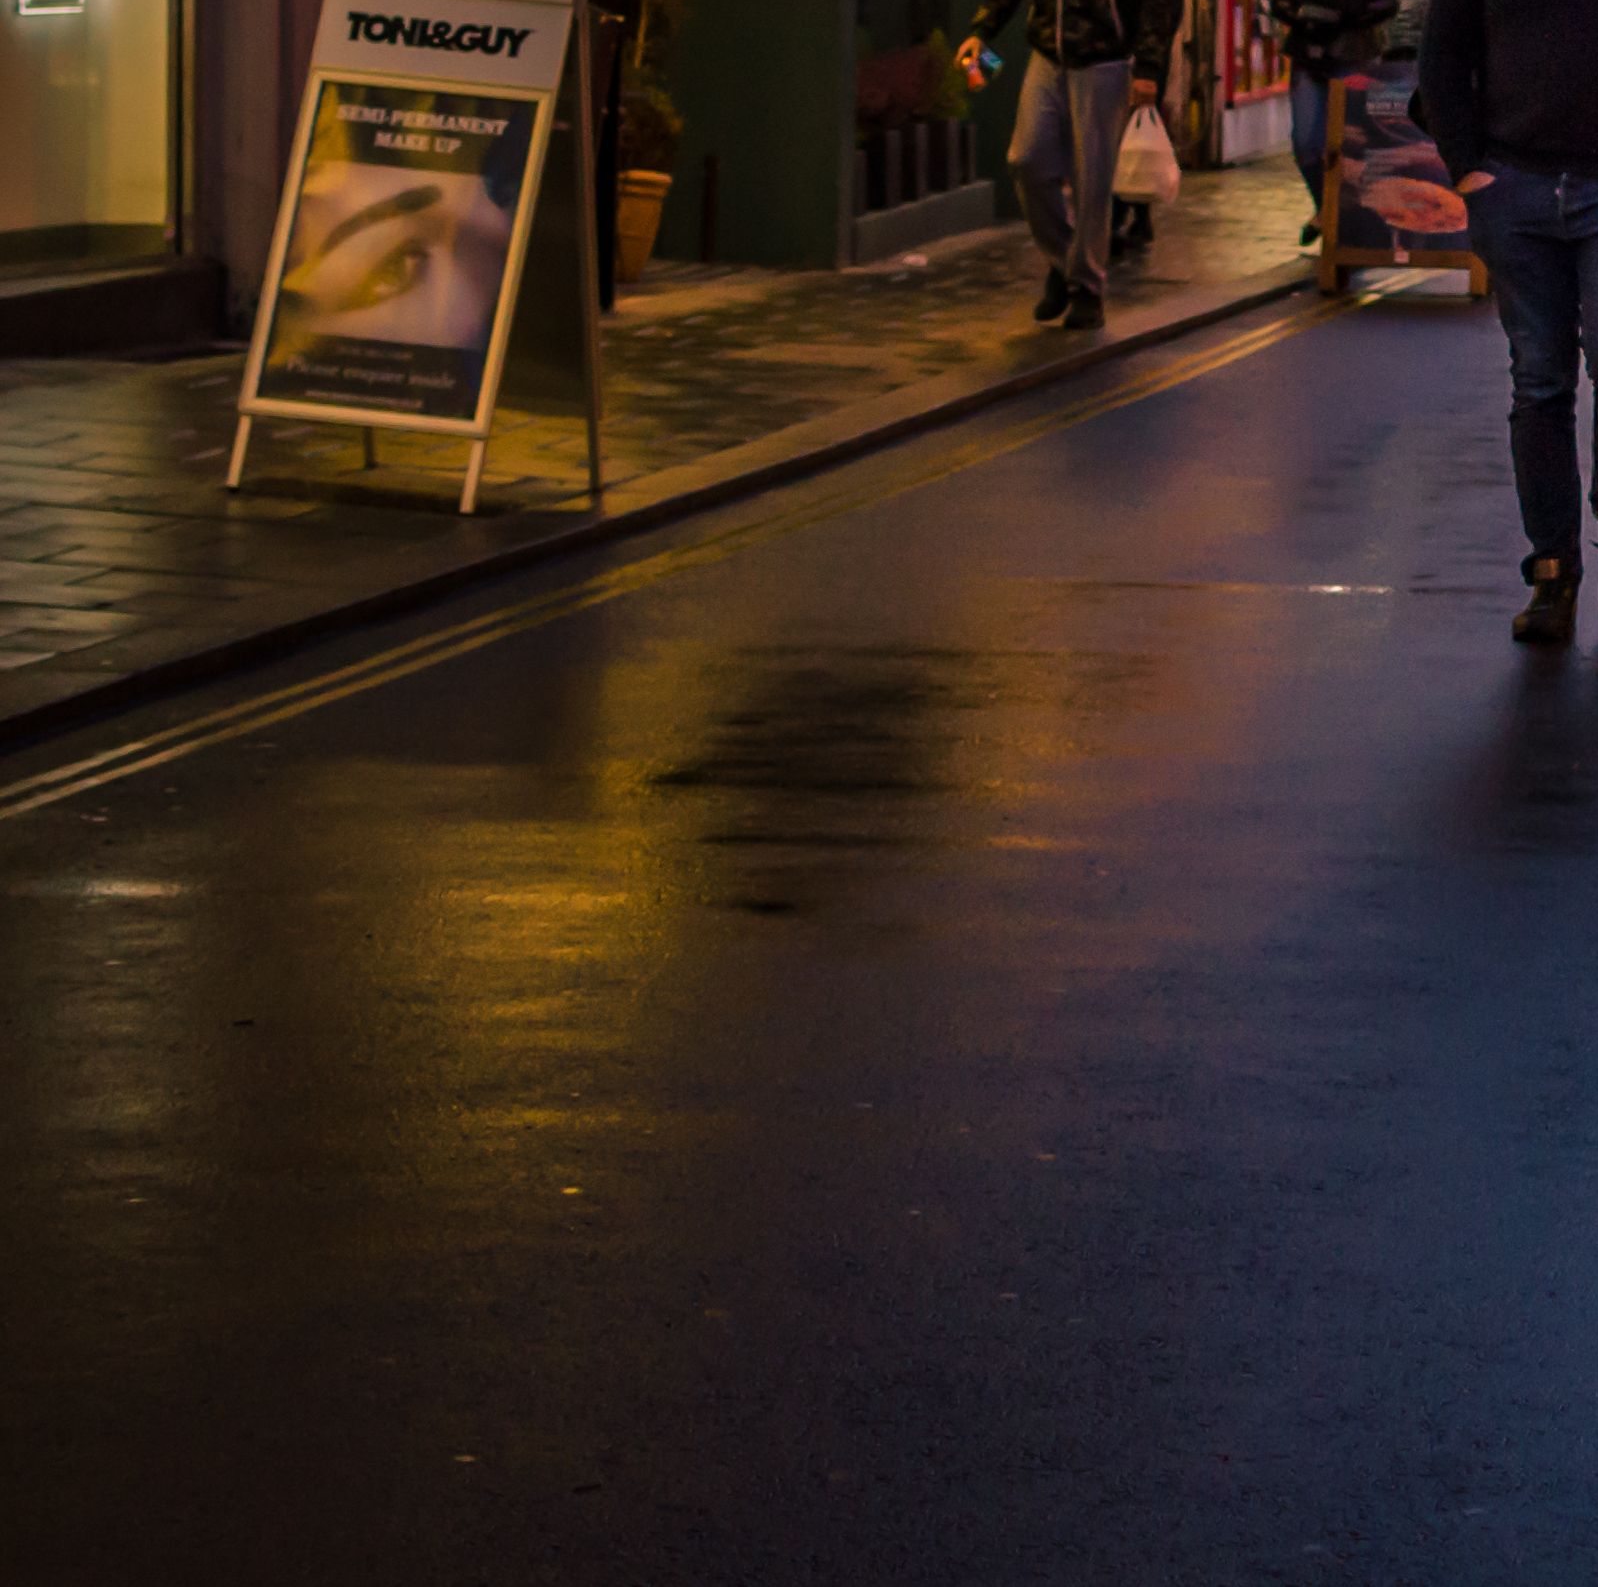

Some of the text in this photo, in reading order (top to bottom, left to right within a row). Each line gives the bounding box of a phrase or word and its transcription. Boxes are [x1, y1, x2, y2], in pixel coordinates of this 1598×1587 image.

[346, 10, 532, 58] TONI&GUY
[373, 130, 462, 154] MAKE UP
